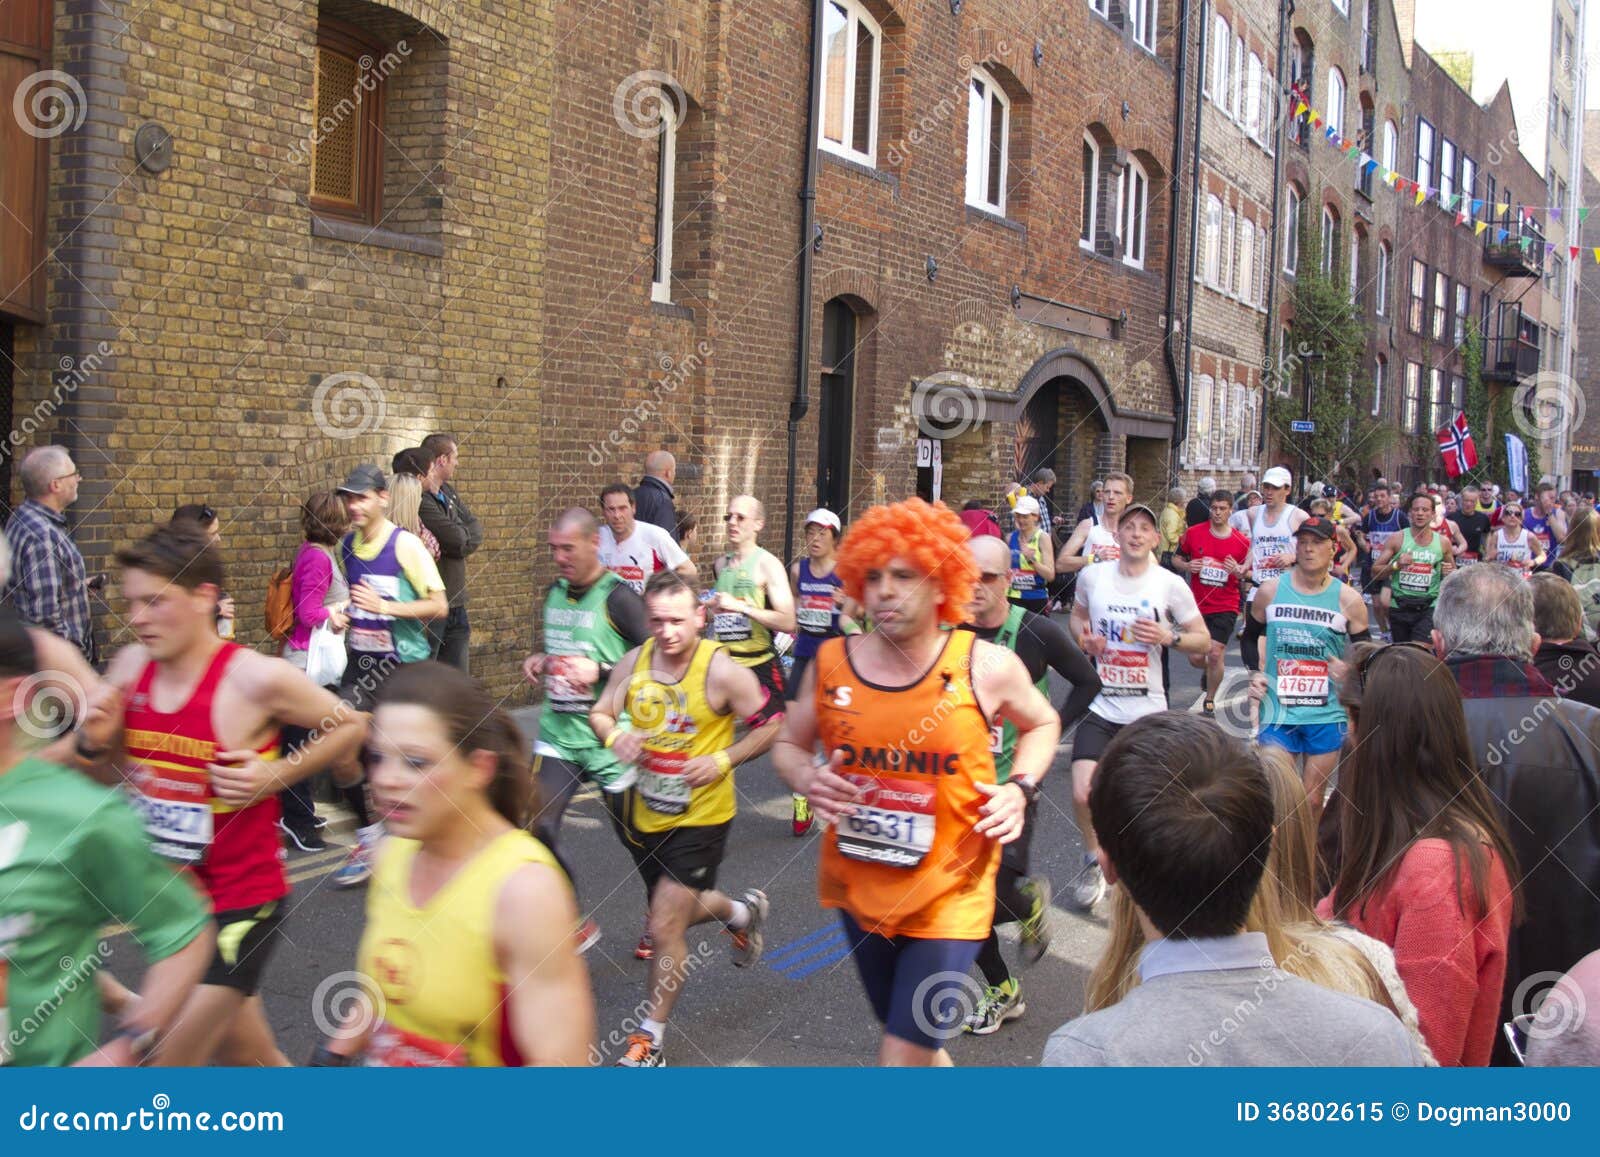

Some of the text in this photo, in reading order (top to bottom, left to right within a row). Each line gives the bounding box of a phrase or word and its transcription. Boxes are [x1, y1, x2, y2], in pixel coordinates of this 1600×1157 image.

[1400, 573, 1429, 584] 27220
[1275, 606, 1336, 623] DRUMMY
[1277, 643, 1327, 657] #TeamRST
[1100, 667, 1147, 684] 45156
[1279, 678, 1326, 693] 47677
